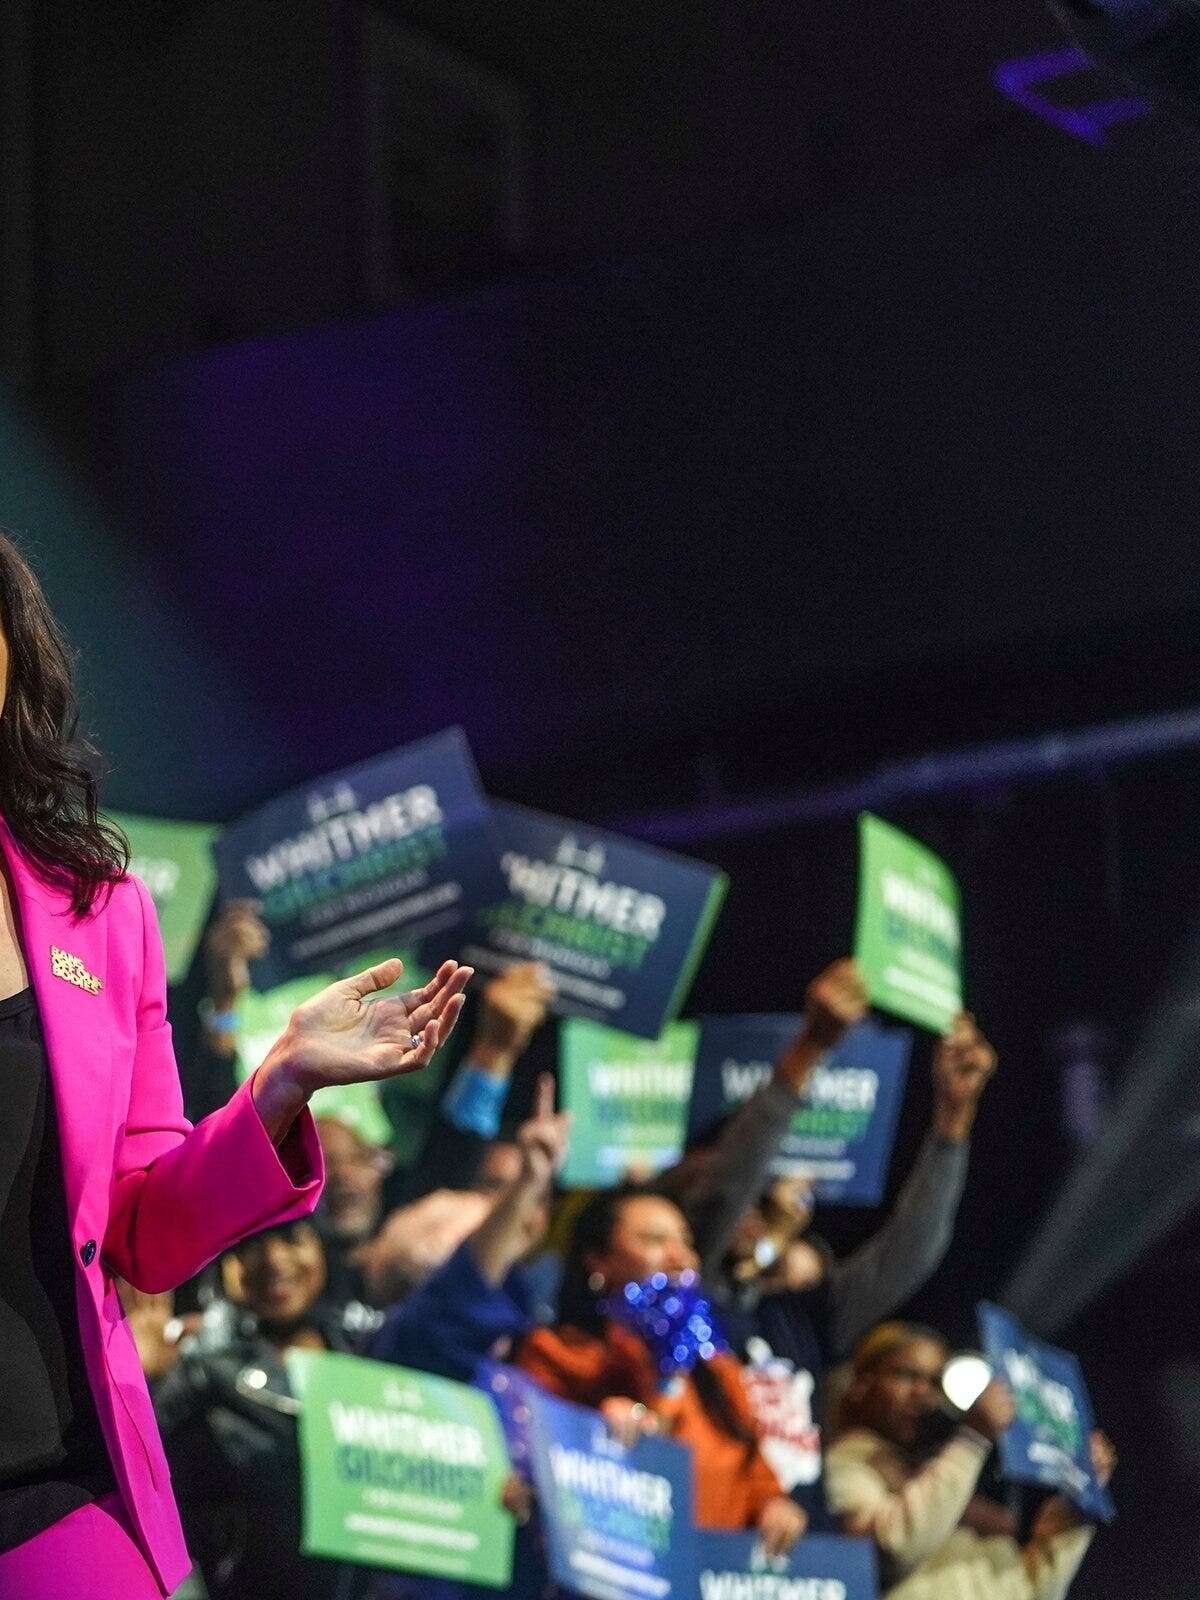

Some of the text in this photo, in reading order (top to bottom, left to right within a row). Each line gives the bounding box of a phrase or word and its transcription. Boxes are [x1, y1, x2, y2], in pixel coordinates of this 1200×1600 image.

[246, 784, 442, 890] WHITMER
[329, 1398, 488, 1469] WHITMER
[337, 1445, 485, 1503] GILCHRIST
[553, 1446, 673, 1518] WHITMER
